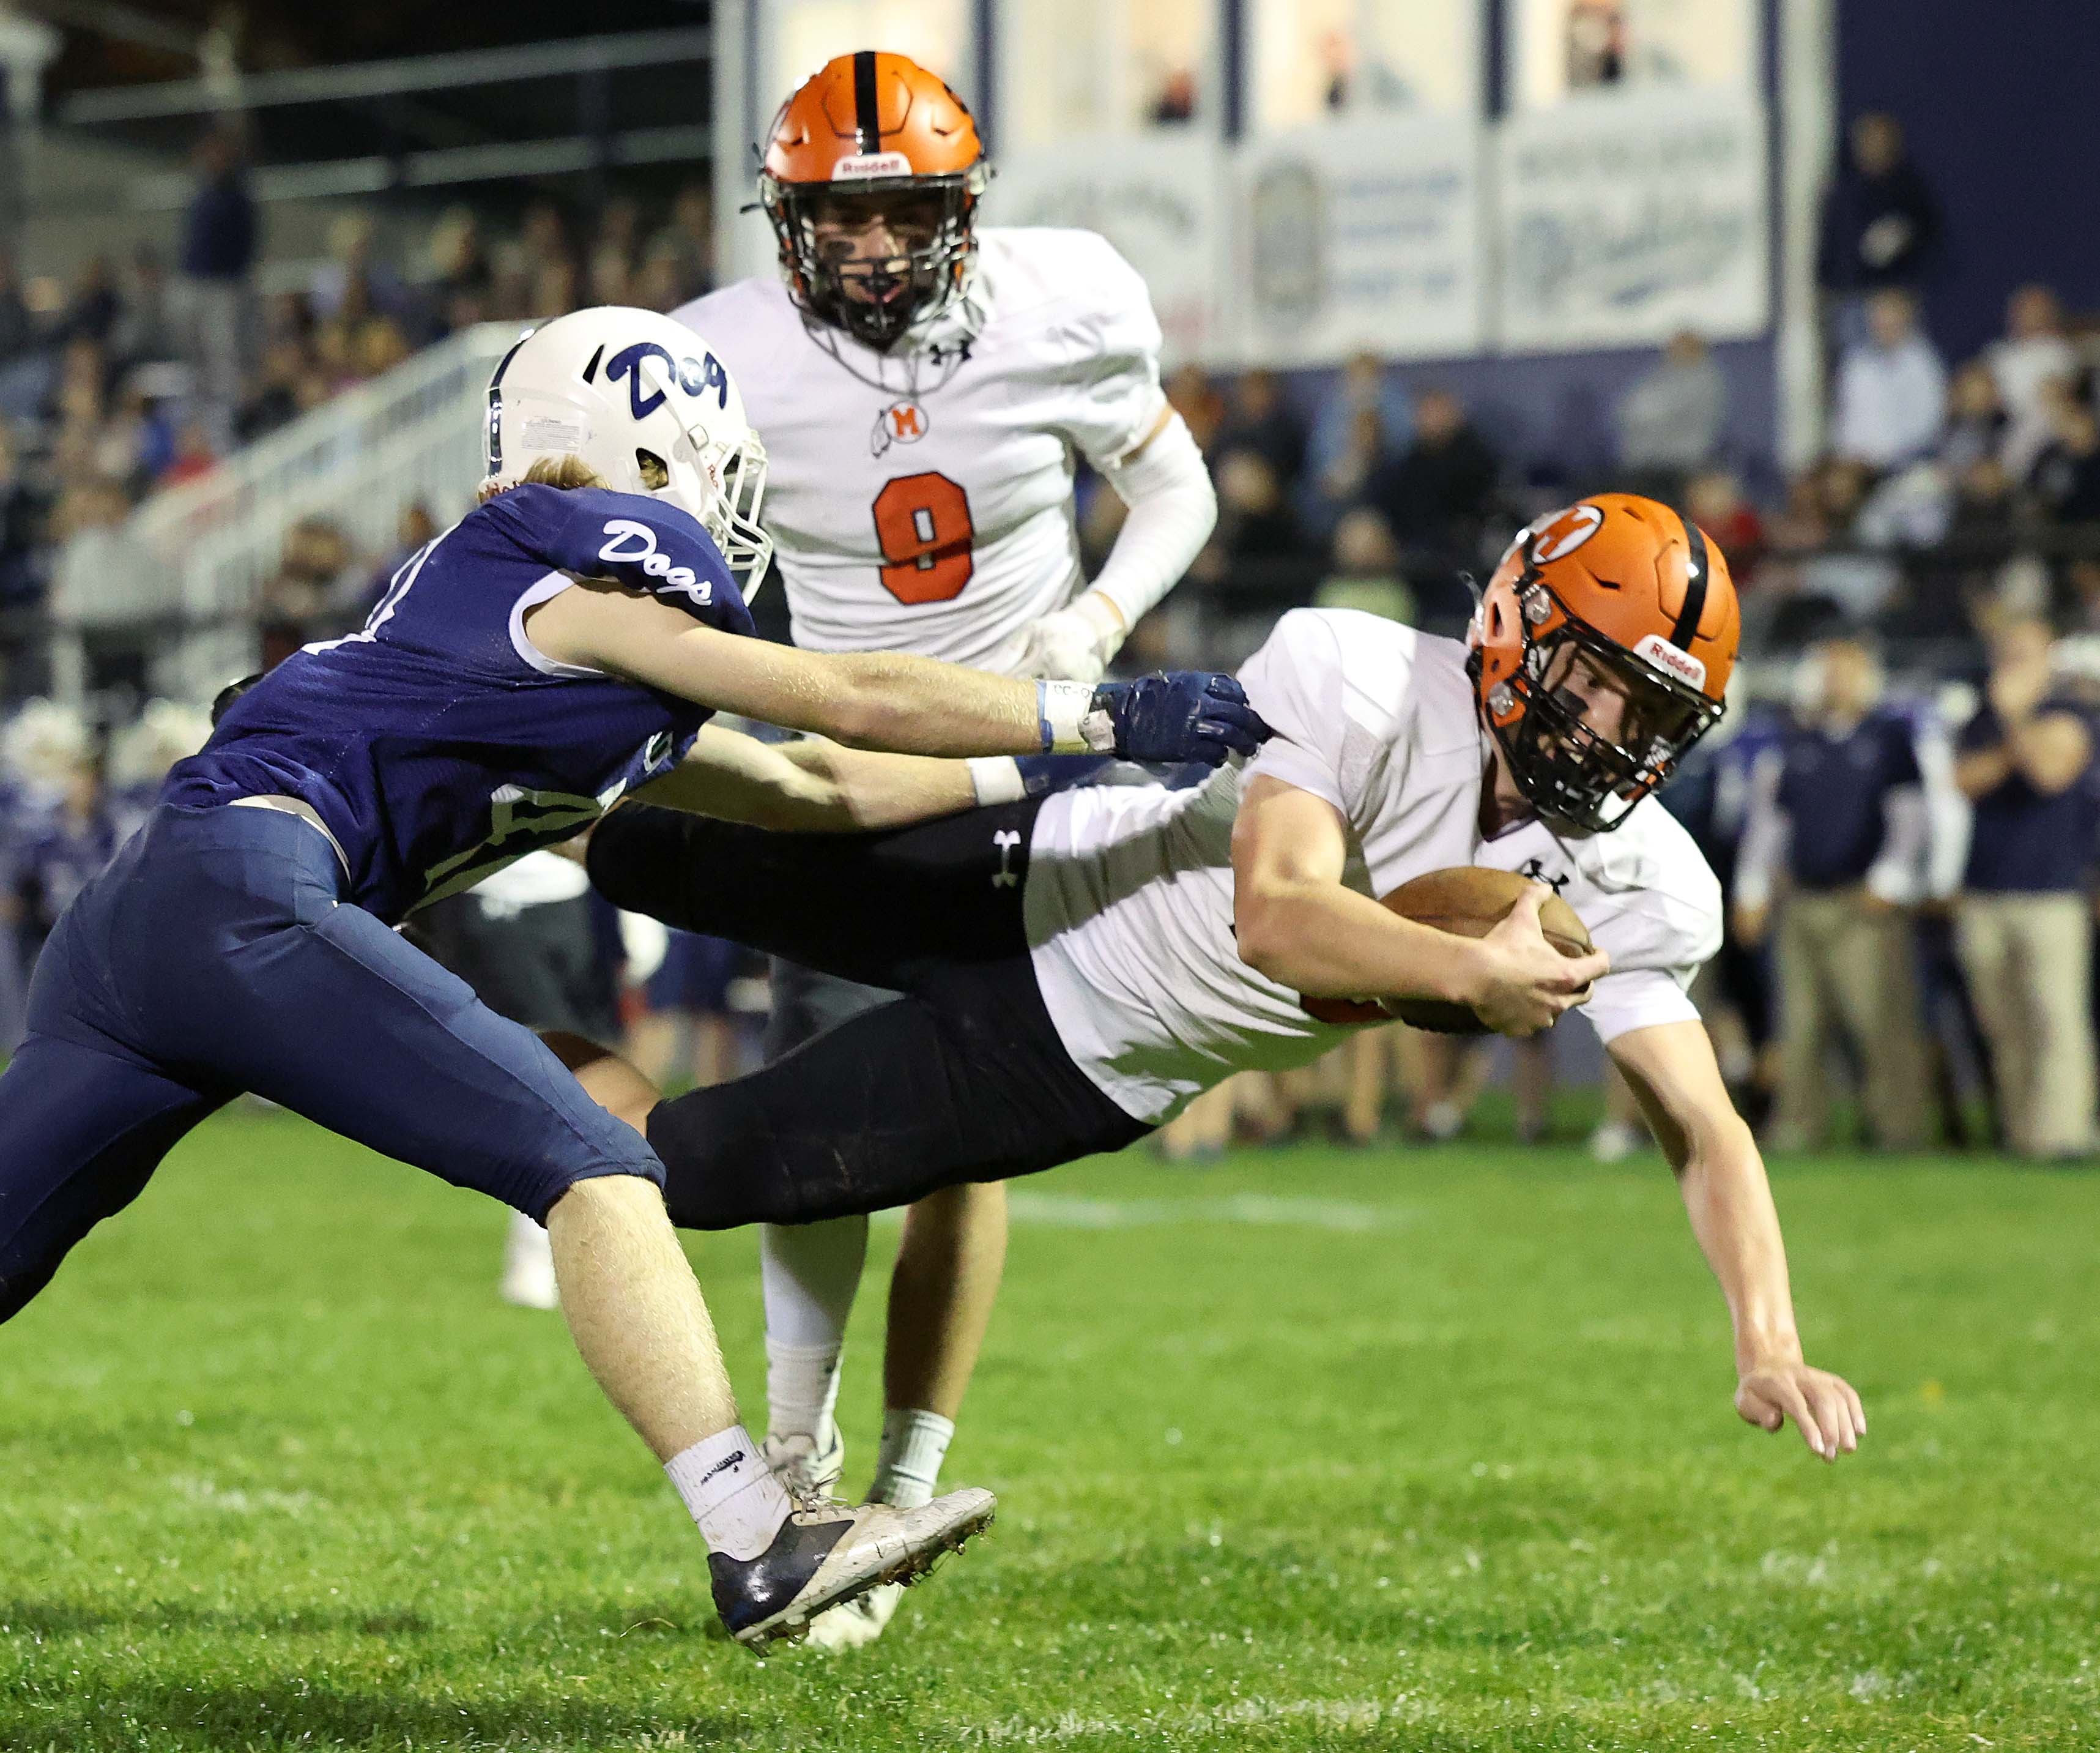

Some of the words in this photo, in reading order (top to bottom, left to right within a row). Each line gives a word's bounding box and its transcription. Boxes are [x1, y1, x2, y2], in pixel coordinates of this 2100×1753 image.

[891, 406, 923, 437] M
[598, 519, 712, 606] Dogs
[872, 471, 974, 606] 9
